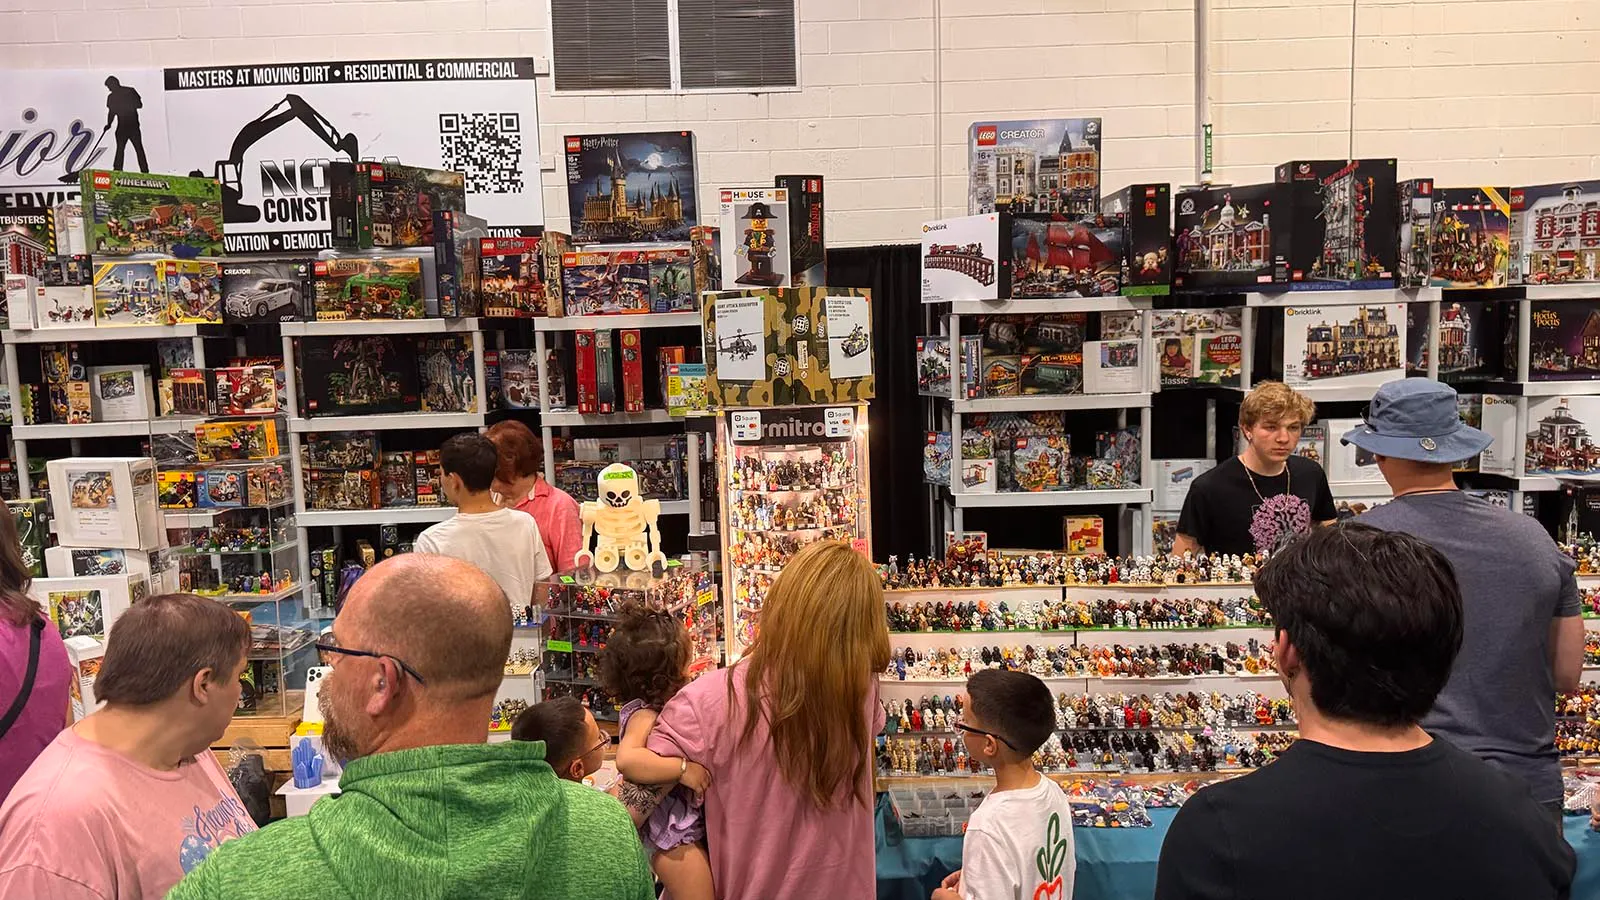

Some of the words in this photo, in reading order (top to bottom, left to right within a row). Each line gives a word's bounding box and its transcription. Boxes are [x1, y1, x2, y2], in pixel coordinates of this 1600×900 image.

[178, 69, 234, 88] MASTERS
[236, 69, 251, 85] AT
[253, 66, 300, 84] MOVING
[303, 65, 331, 82] DIRT
[344, 63, 423, 81] RESIDENTIAL
[425, 62, 435, 79] &
[437, 61, 519, 79] COMMERCIAL
[979, 131, 996, 140] LEGO
[1000, 129, 1045, 140] CREATOR
[0, 108, 106, 183] ior
[978, 152, 991, 160] 16+
[95, 176, 110, 185] LEGO
[114, 177, 171, 189] MINECRAFT
[263, 197, 331, 223] CONST
[0, 215, 46, 225] TBUSTERS
[488, 229, 522, 238] TIONS
[224, 234, 270, 252] AVATION
[282, 232, 333, 250] DEMOLIT
[1160, 376, 1189, 385] classic
[760, 416, 826, 438] rmitro
